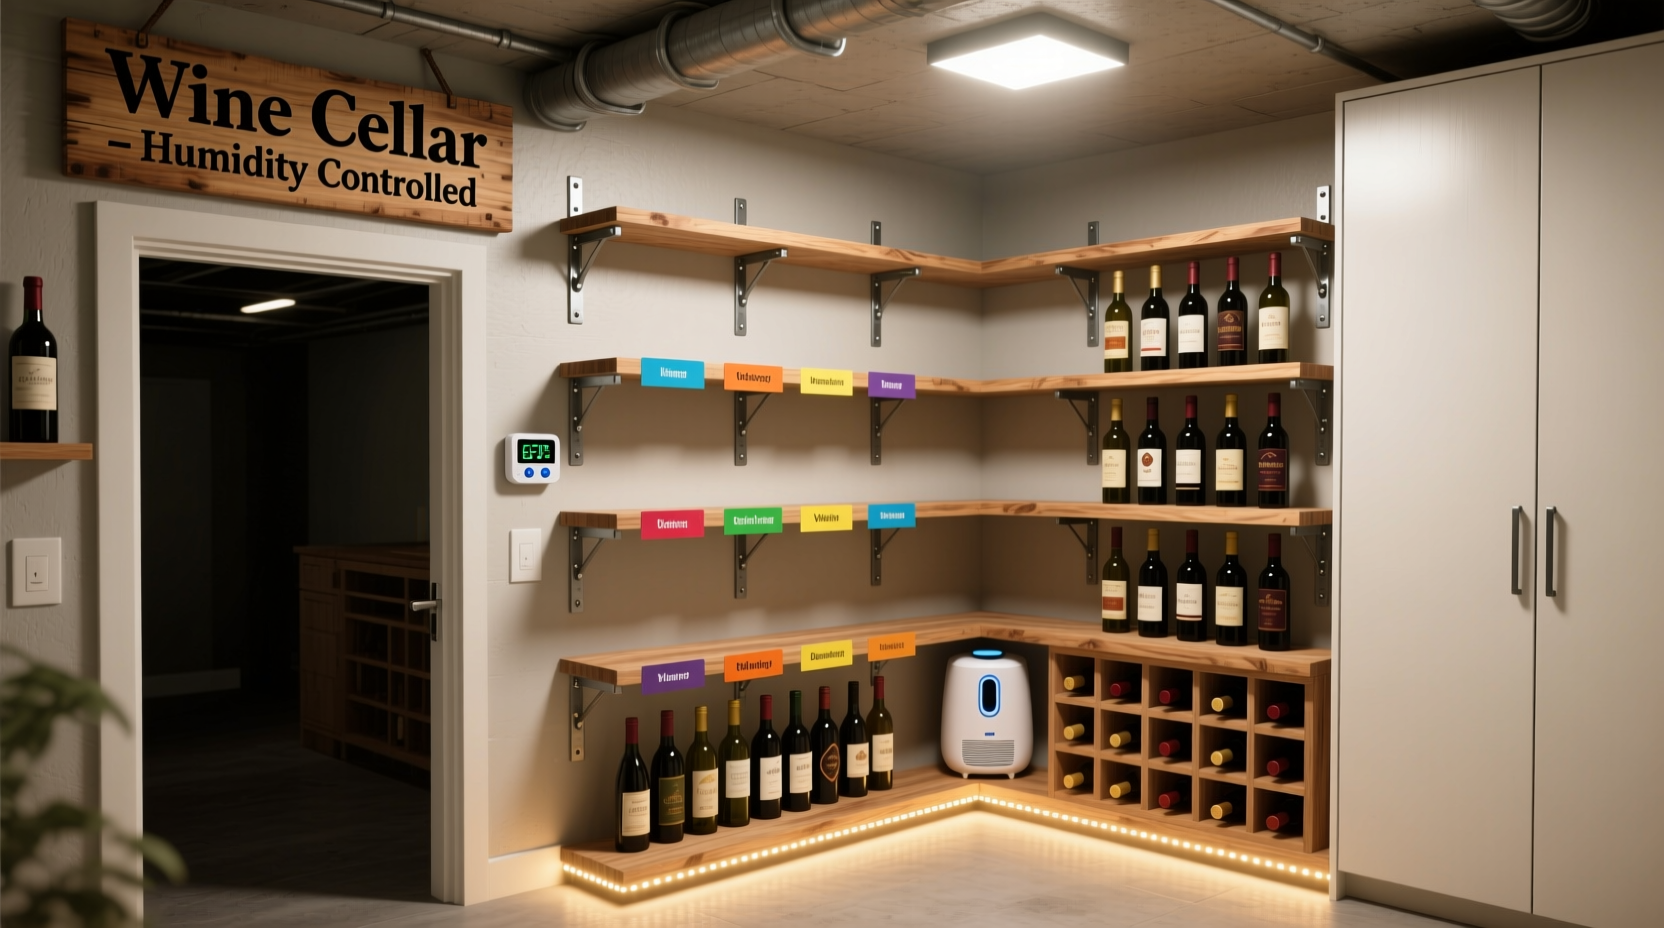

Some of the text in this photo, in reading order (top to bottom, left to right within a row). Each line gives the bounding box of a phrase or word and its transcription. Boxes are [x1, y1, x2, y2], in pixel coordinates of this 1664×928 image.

[105, 48, 487, 169] Wine Cellar
[141, 130, 308, 192] Humidity
[317, 158, 477, 207] Controlled
